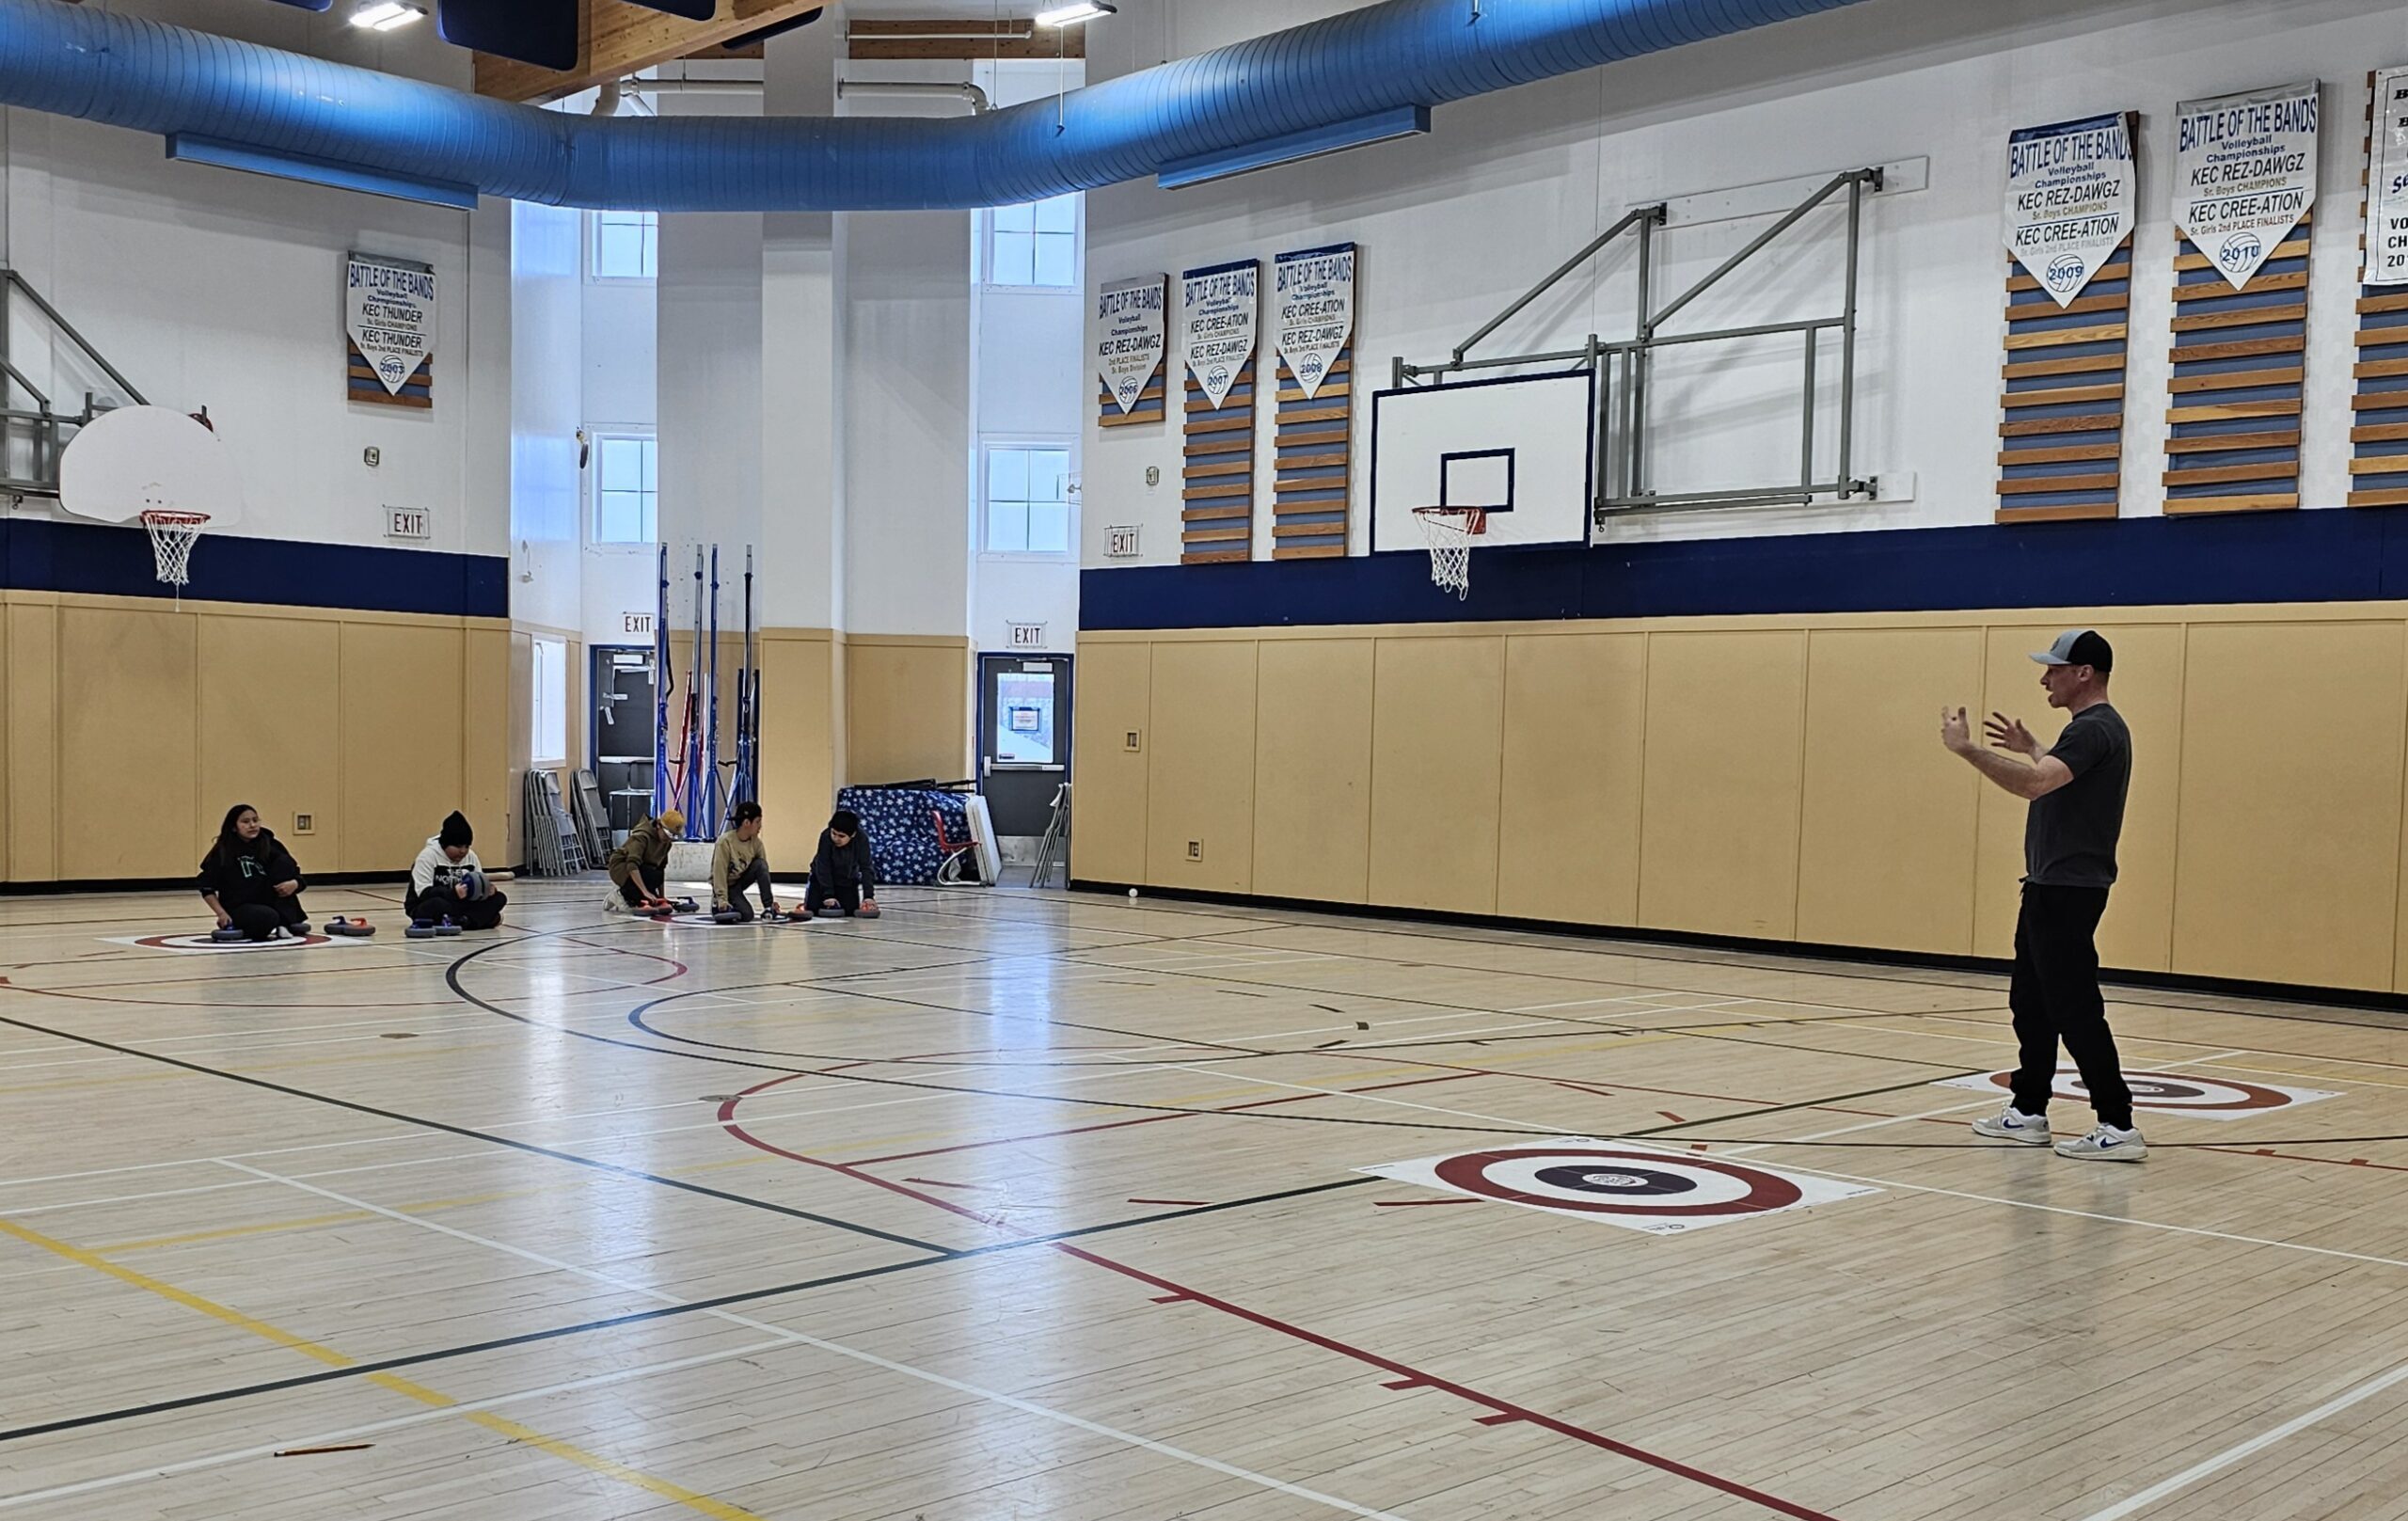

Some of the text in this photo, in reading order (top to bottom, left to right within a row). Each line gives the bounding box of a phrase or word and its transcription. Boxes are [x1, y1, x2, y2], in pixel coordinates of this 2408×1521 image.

[2179, 97, 2316, 152] BATTLE OF THE BANDS
[2222, 135, 2272, 151] Volleyball
[2010, 141, 2051, 178] BATTLE
[2053, 137, 2068, 164] OF
[2072, 133, 2093, 160] THE
[2207, 144, 2286, 163] Championships
[2048, 162, 2094, 177] Volleyball
[2191, 152, 2305, 186] KEC REZ-DAWGZ
[2036, 171, 2106, 188] Championships
[2204, 177, 2287, 197] Sr. Boys CHAMPIONS
[2018, 180, 2120, 211] KEC REZ-DAWGZ
[2033, 202, 2107, 220] Sr. Boys CHAMPIONS
[2189, 192, 2304, 223] KEC CREE-ATION
[2016, 217, 2119, 246] KEC CREE-ATION
[2191, 214, 2294, 236] Sr. Girls 2nd PLACE FINALISTS
[2031, 246, 2043, 255] Girls
[2045, 244, 2057, 254] 2nd
[2059, 240, 2079, 252] PLACE
[2081, 237, 2115, 248] FINALISTS
[2223, 245, 2258, 261] 2010
[1277, 256, 1352, 292] BATTLE OF THE BANDS
[2050, 265, 2083, 280] 2009
[350, 264, 434, 301] BATTLE OF THE BANDS
[1185, 272, 1254, 308] BATTLE OF THE BANDS
[1300, 282, 1327, 292] Volleyball
[376, 289, 407, 299] Volleyball
[1100, 286, 1162, 319] BATTLE OF THE BANDS
[1206, 297, 1231, 307] Volleyball
[1291, 290, 1335, 300] Championships
[362, 303, 422, 324] KEC THUNDER
[1198, 305, 1239, 315] Championships
[1281, 298, 1345, 320] KEC CREE-ATION
[388, 321, 417, 331] CHAMPIONS
[1118, 313, 1140, 324] Volleyball
[1191, 313, 1248, 334] KEC CREE-ATION
[362, 329, 421, 349] KEC THUNDER
[1111, 325, 1148, 336] Championships
[1214, 328, 1239, 339] CHAMPIONS
[1282, 325, 1343, 345] KEC REZ-DAWGZ
[388, 345, 401, 354] PLACE
[402, 348, 423, 356] FINALISTS
[1099, 334, 1161, 356] KEC REZ-DAWGZ
[1191, 340, 1247, 359] KEC REZ-DAWGZ
[1307, 343, 1318, 352] PLACE
[1117, 356, 1129, 365] PLACE
[1208, 374, 1228, 386] 2007
[395, 514, 421, 534] EXIT
[1114, 532, 1134, 552] EXIT
[625, 615, 651, 632] EXIT
[1015, 626, 1040, 643] EXIT
